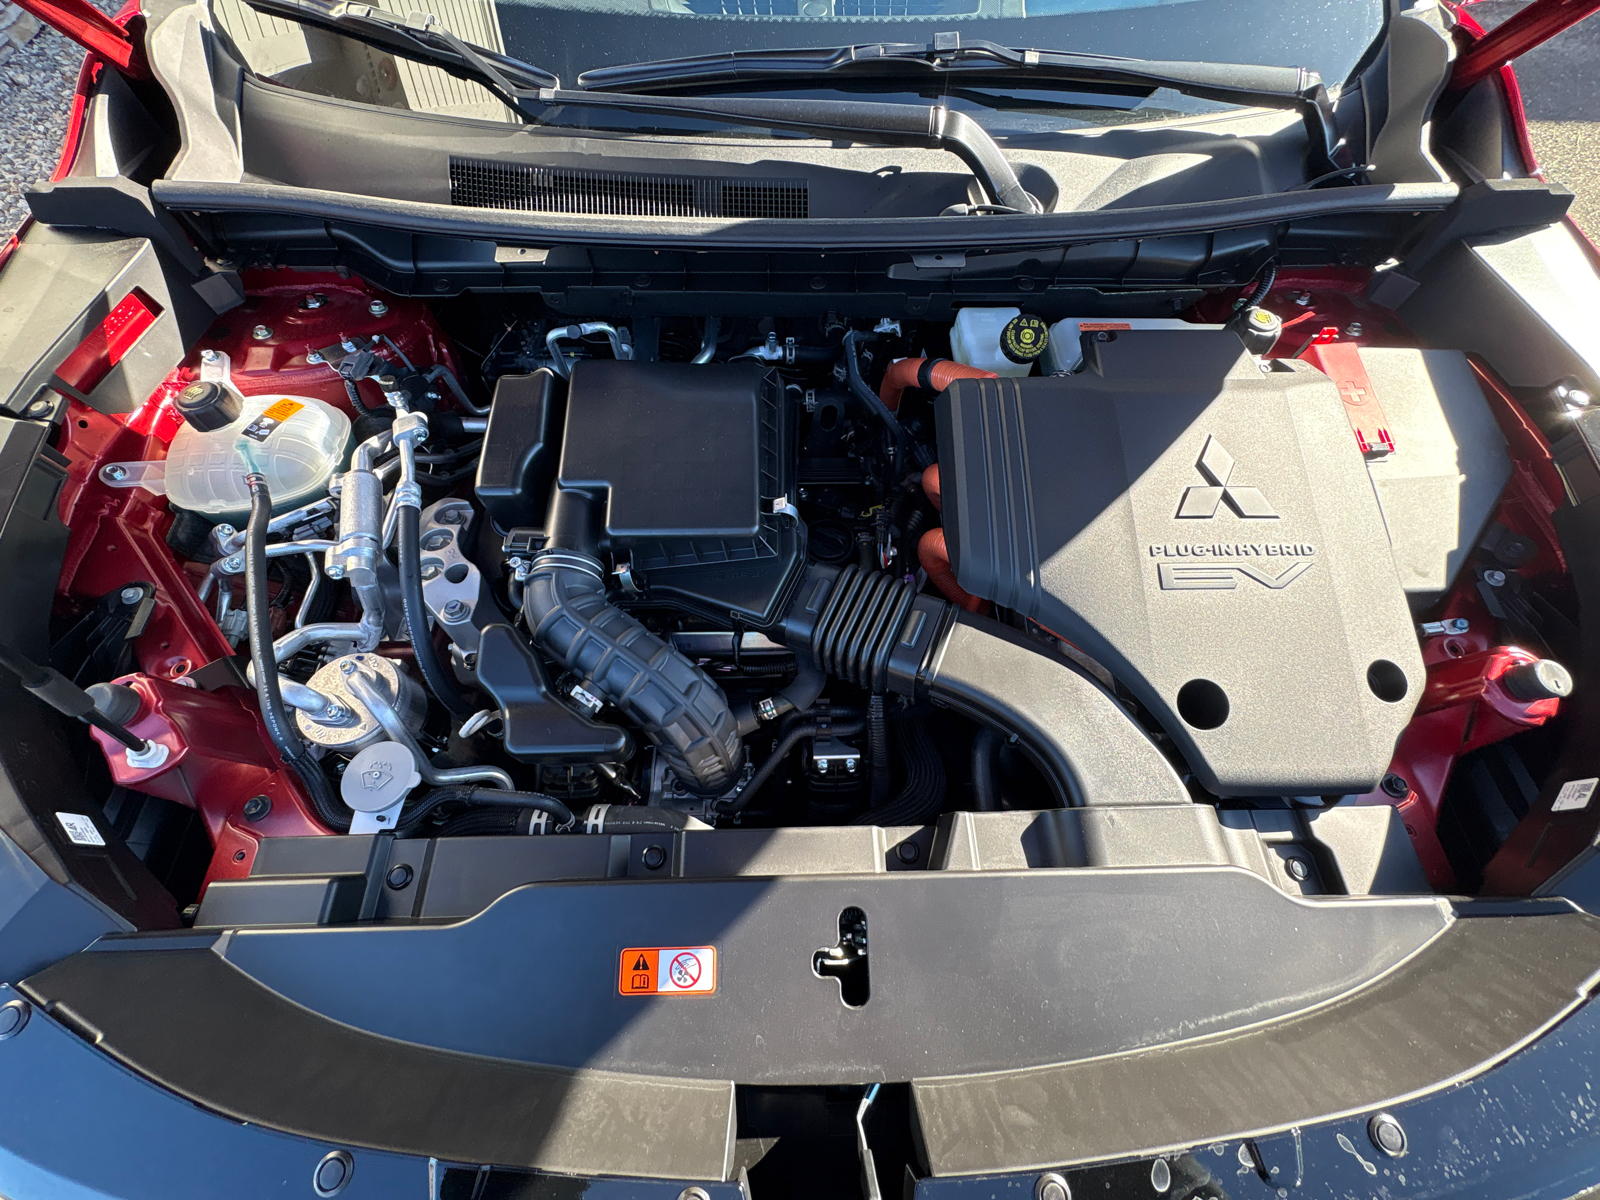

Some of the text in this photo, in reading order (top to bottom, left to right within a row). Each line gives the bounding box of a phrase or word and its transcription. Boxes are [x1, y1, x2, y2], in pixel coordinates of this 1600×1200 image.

[1149, 543, 1316, 557] PLUG-IN HYBRID
[1157, 562, 1315, 590] EV
